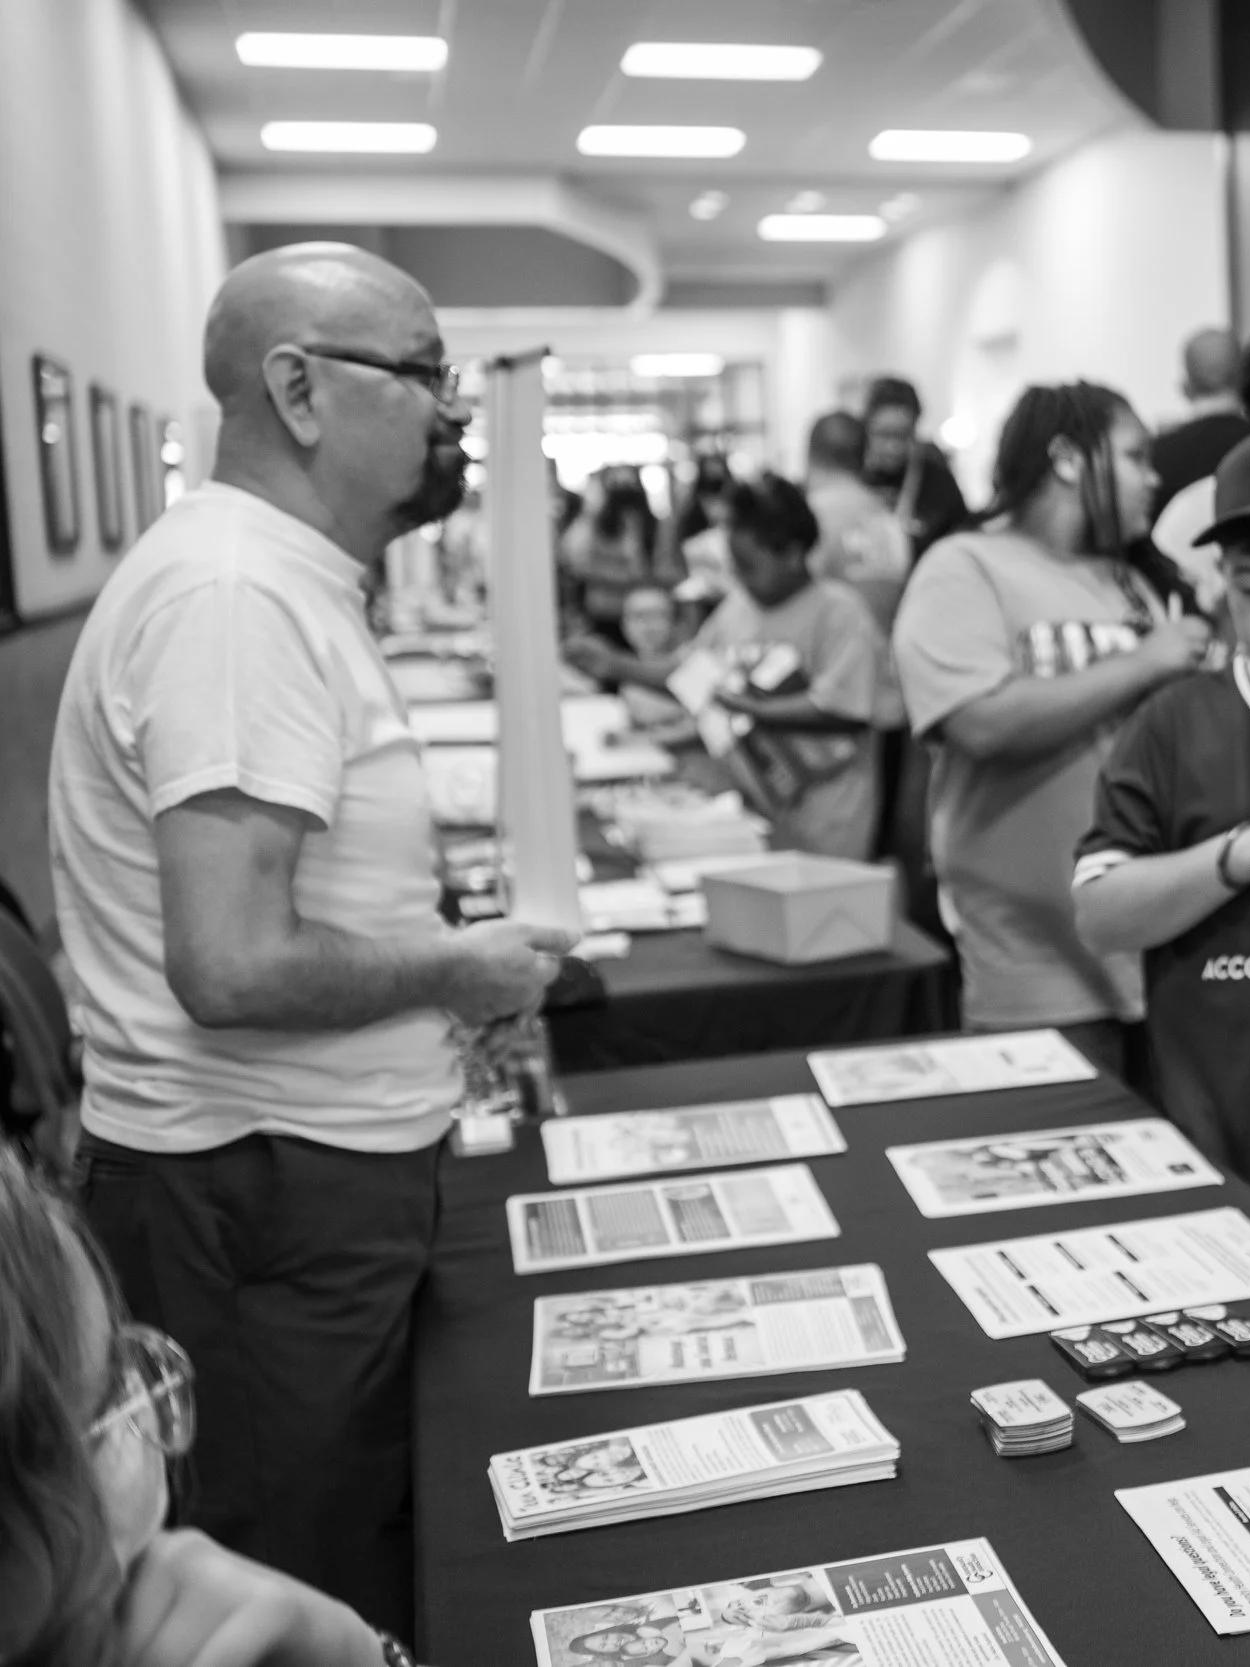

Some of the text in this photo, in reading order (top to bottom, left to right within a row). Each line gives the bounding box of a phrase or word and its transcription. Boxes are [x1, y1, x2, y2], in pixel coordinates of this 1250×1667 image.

[1208, 1580, 1230, 1596] have
[1221, 1596, 1243, 1607] you
[1229, 1608, 1248, 1617] Do
